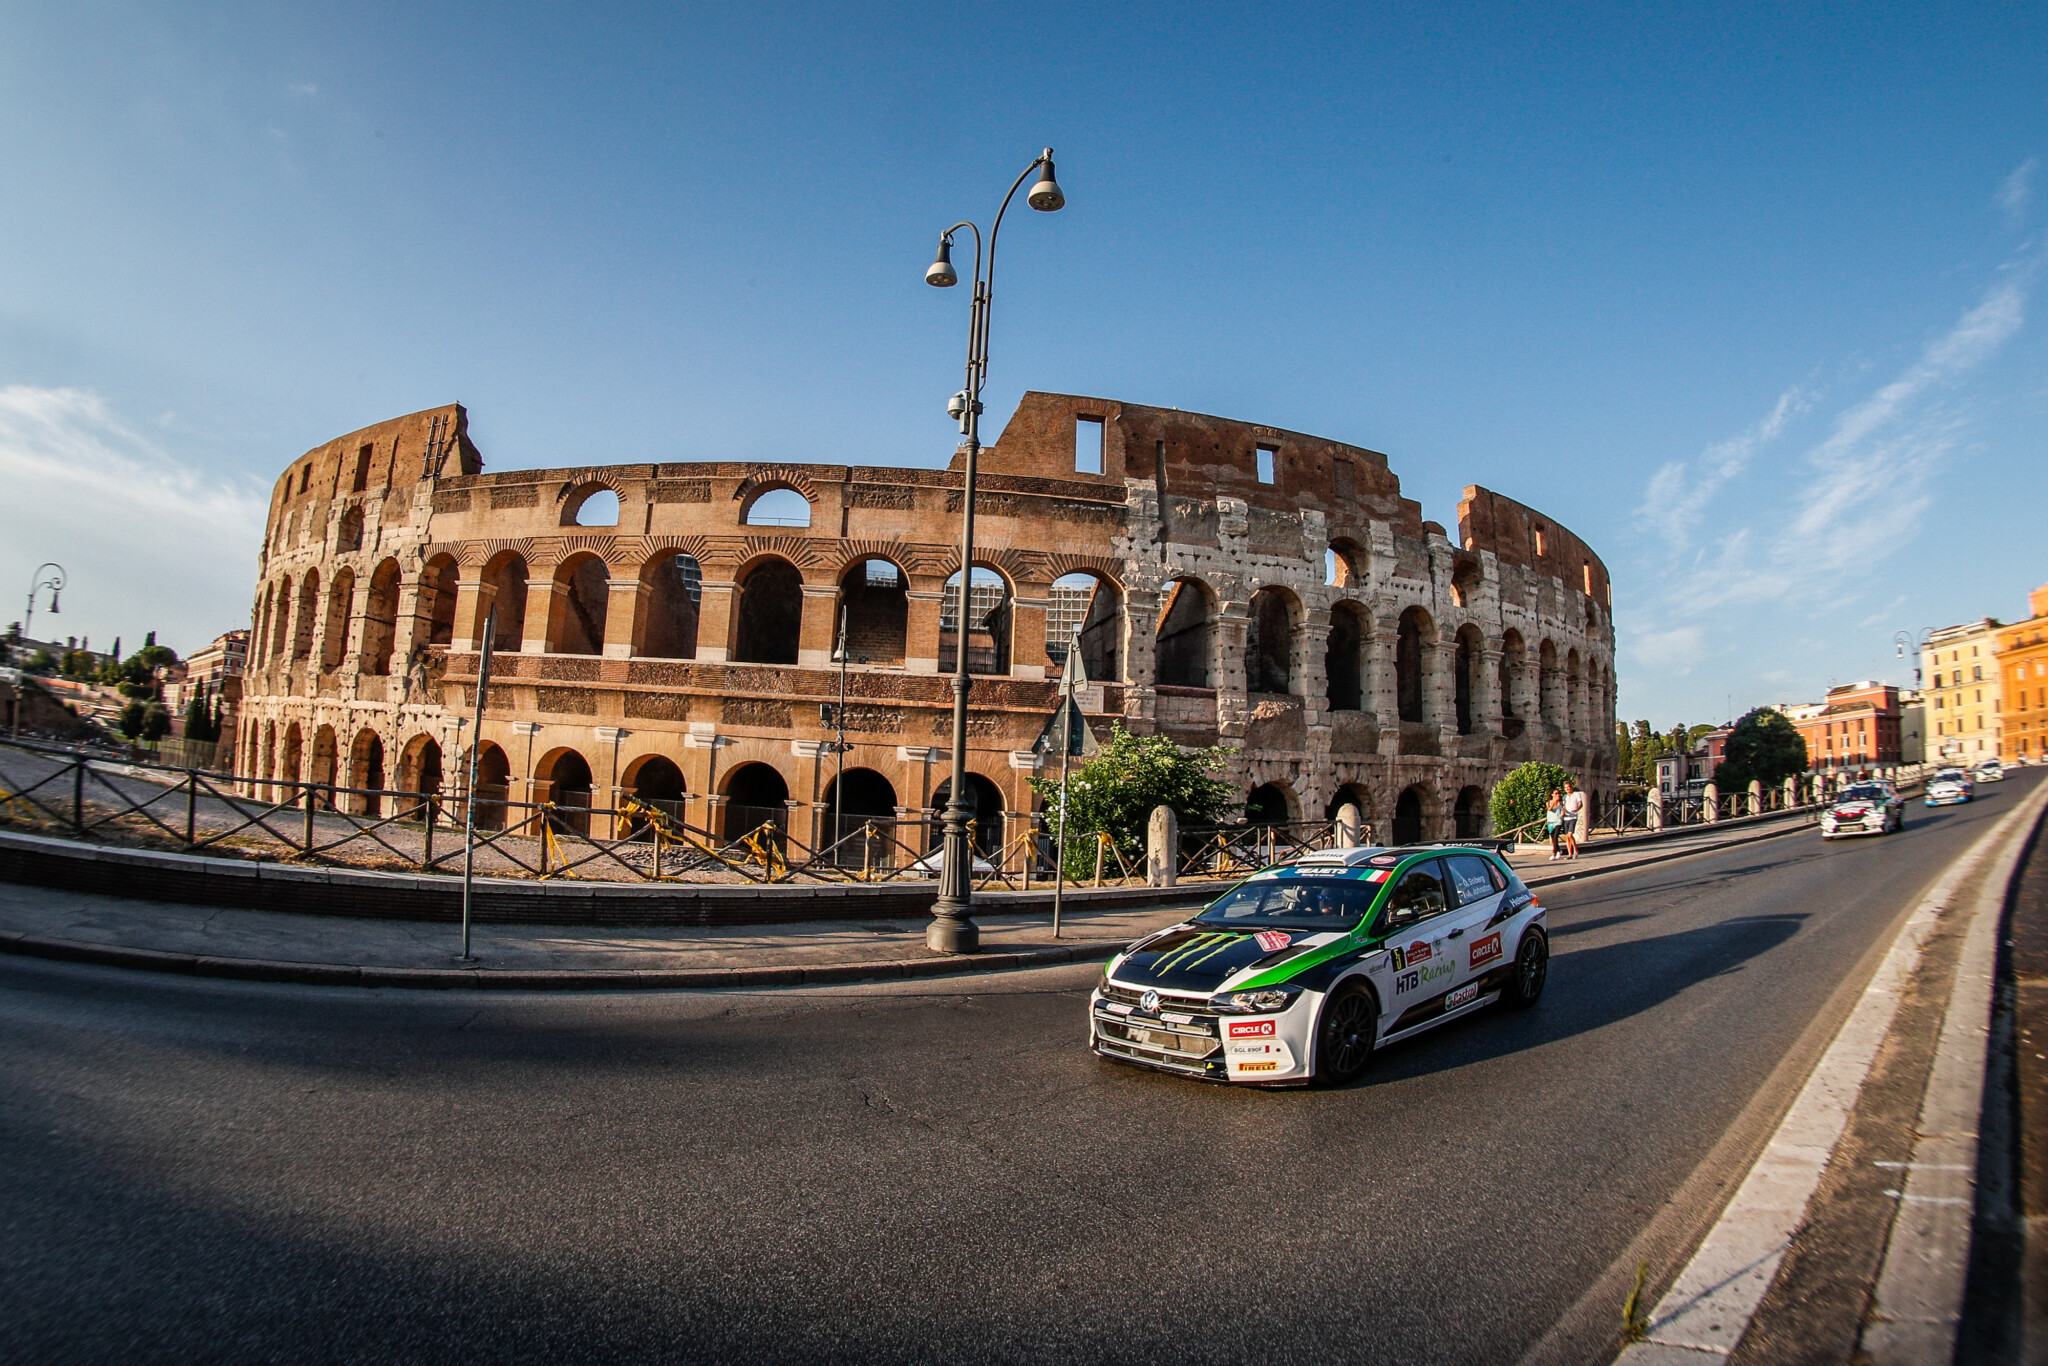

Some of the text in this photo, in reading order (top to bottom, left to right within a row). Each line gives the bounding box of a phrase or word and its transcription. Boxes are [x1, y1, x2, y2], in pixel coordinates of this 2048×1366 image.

[1294, 867, 1348, 875] SEAJETS
[1393, 948, 1402, 971] 5
[1472, 944, 1491, 960] CIRCLE
[1396, 971, 1419, 995] HTB
[1419, 957, 1456, 985] Racing
[1452, 984, 1478, 1007] Castrol
[1231, 1025, 1260, 1035] CIRCLE
[1239, 1062, 1277, 1071] PIRELLI
